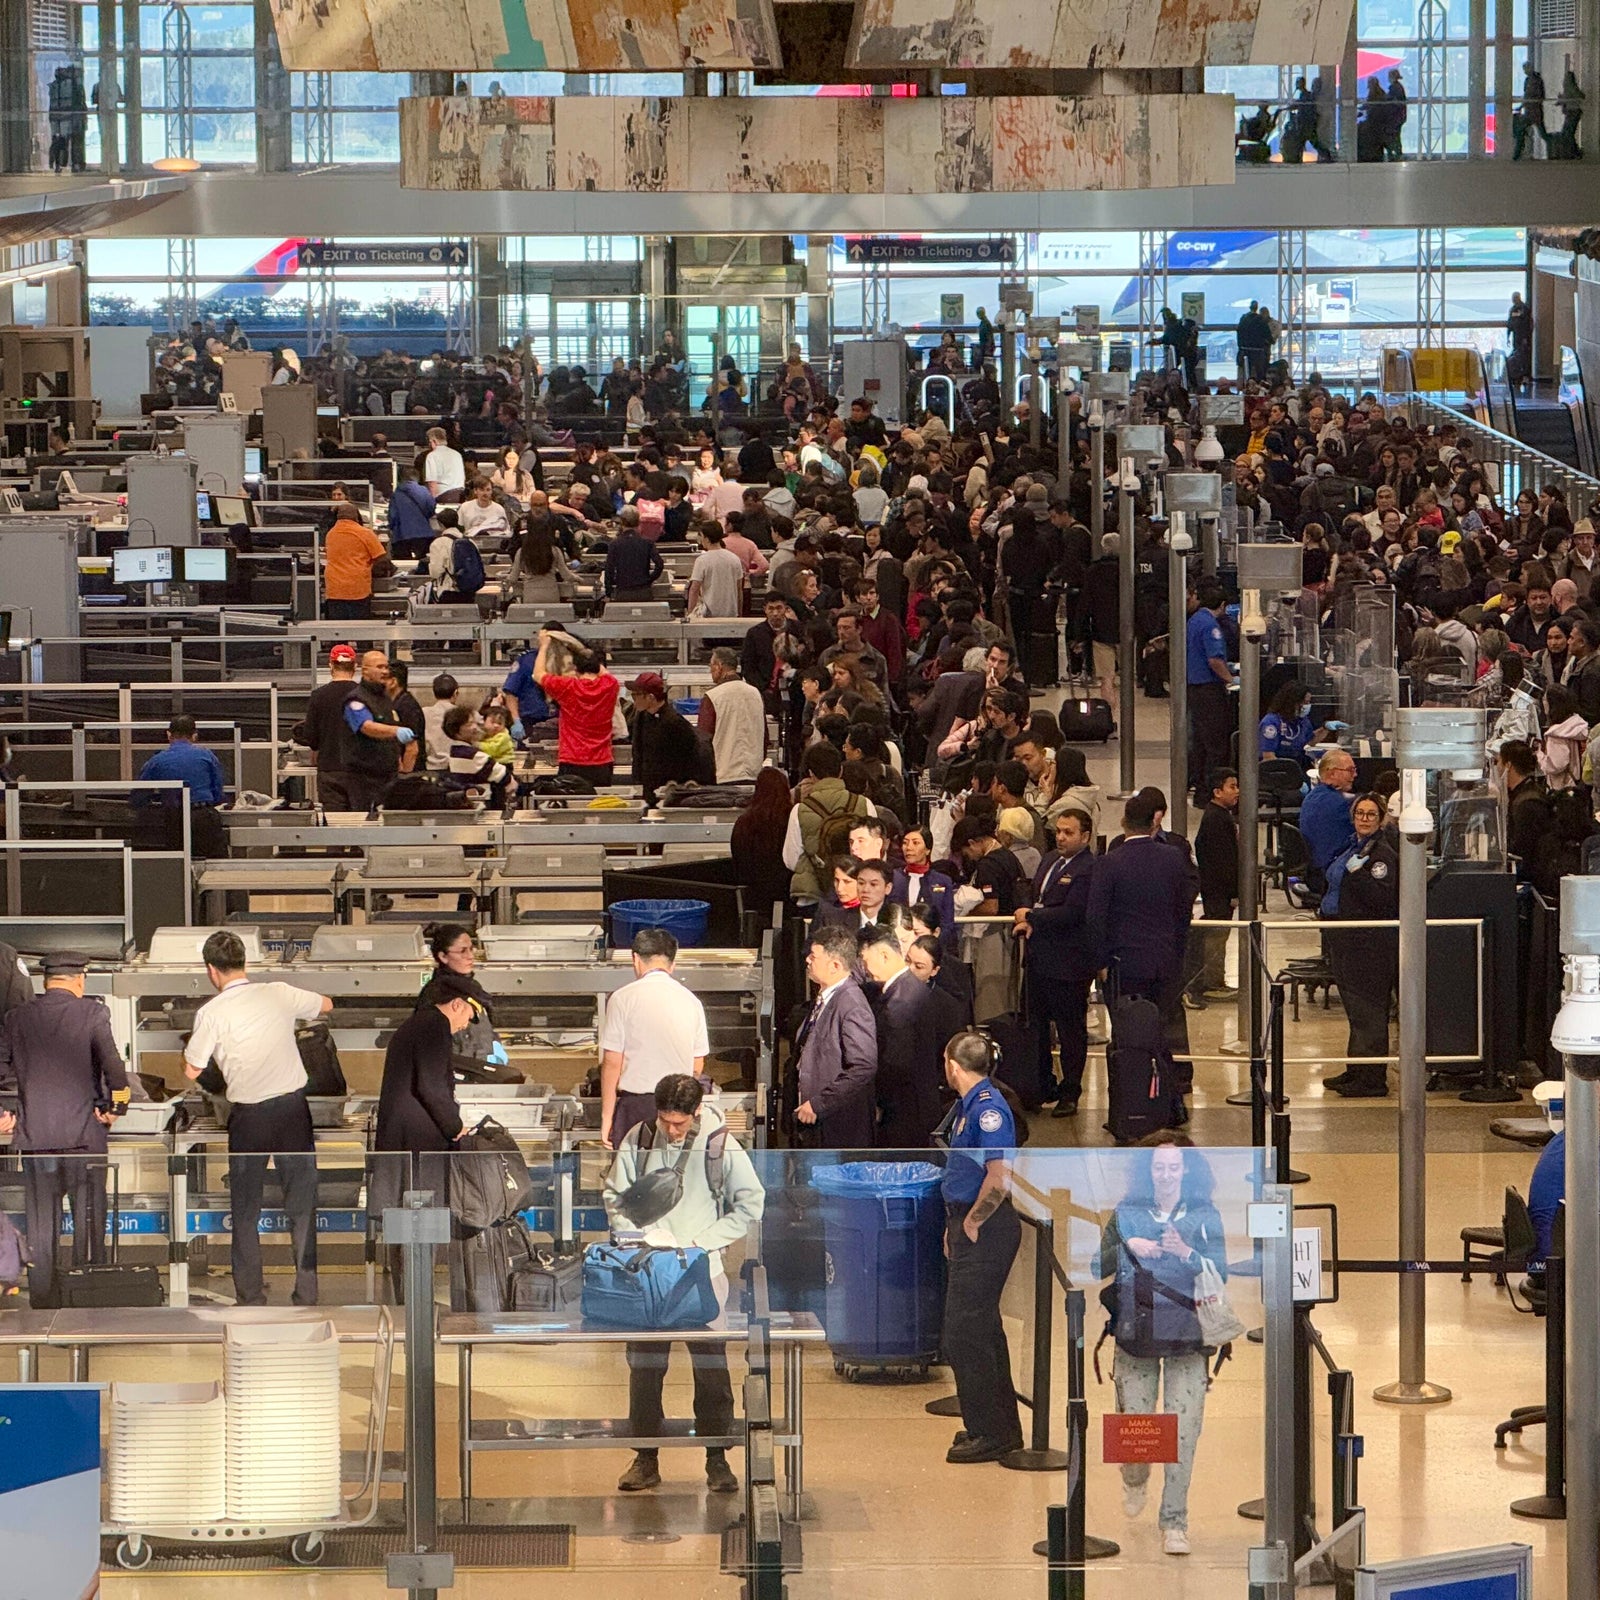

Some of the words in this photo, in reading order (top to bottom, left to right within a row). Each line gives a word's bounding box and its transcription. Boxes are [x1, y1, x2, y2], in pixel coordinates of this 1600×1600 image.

[323, 250, 351, 261] EXIT
[355, 251, 367, 261] to
[370, 250, 424, 262] Ticketing
[872, 246, 899, 257] EXIT
[903, 247, 915, 257] to
[918, 246, 973, 258] Ticketing
[222, 397, 235, 409] 15
[6, 493, 20, 508] 10
[1140, 563, 1153, 573] TSA
